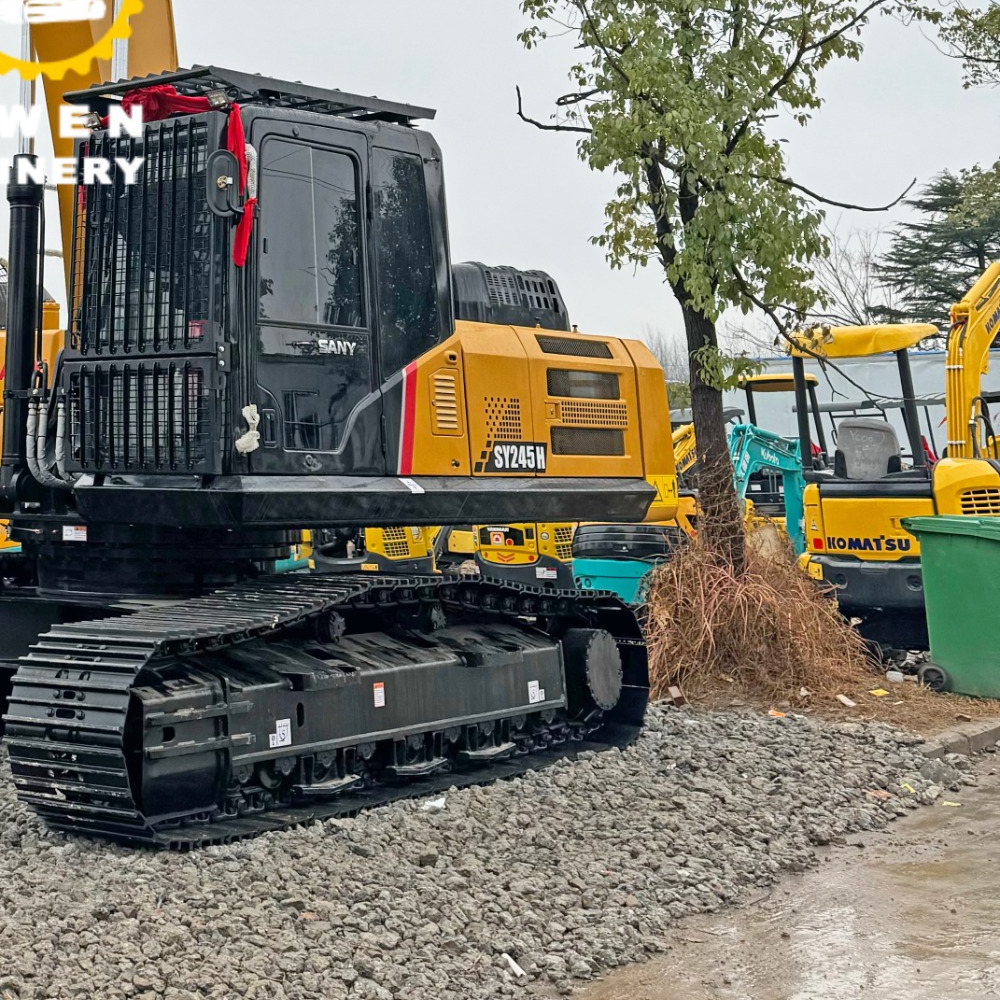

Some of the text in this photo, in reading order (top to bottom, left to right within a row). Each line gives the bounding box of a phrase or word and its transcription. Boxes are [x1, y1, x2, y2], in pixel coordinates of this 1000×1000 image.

[318, 339, 356, 356] SANY
[493, 445, 546, 470] SY245H
[826, 535, 911, 552] KOMATSU
